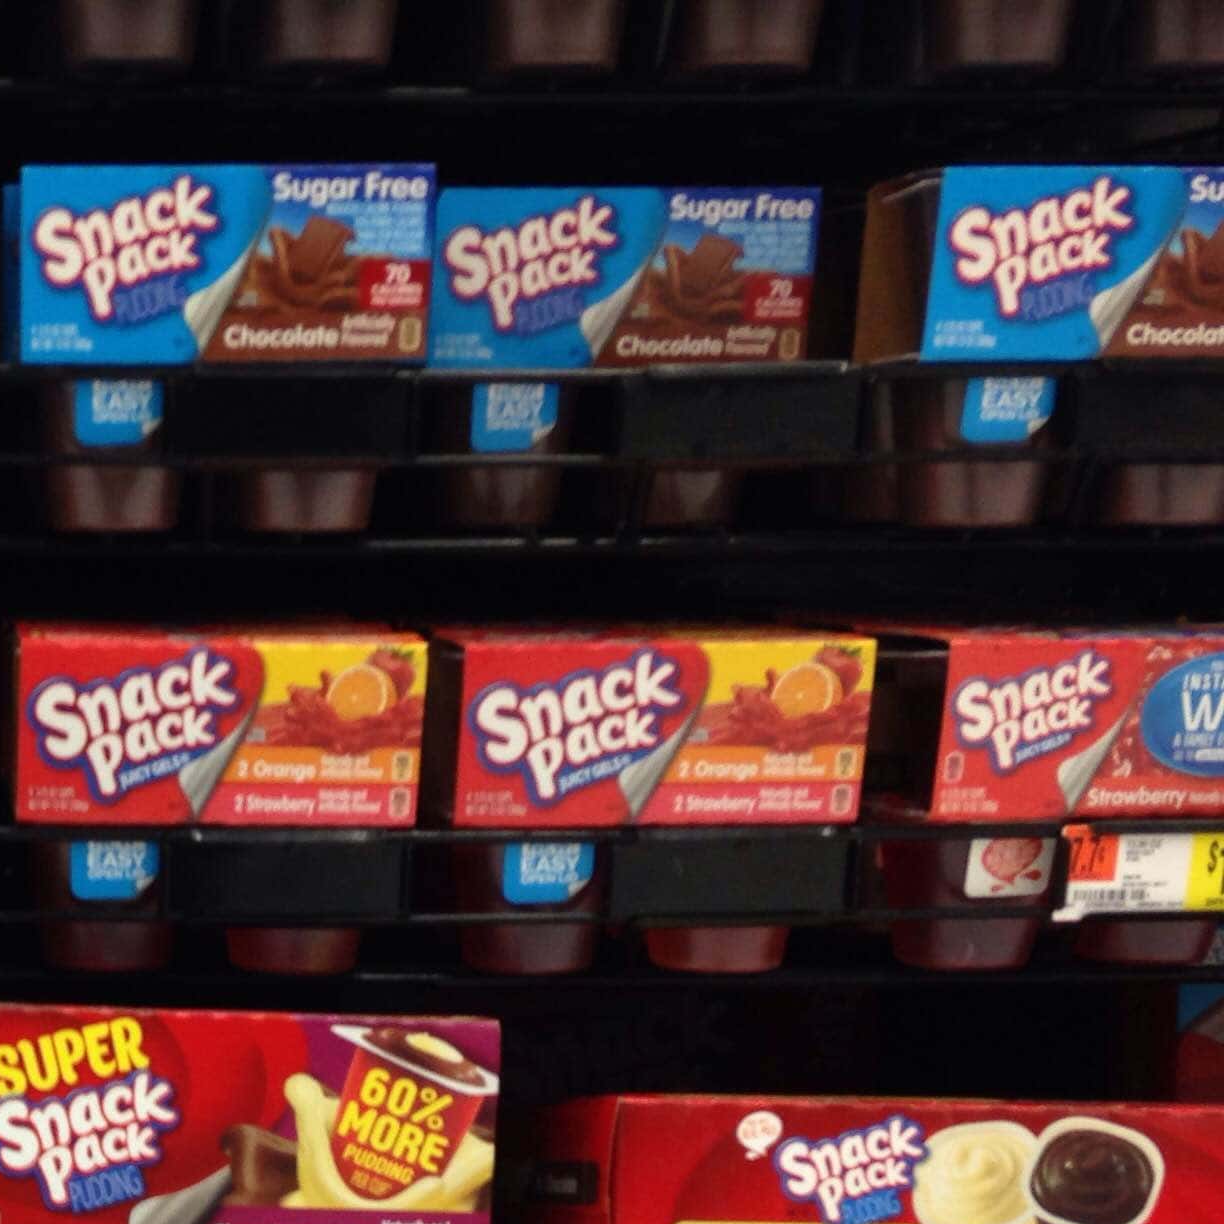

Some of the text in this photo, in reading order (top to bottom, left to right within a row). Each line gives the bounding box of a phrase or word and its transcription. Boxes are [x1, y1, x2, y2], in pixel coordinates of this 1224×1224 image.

[273, 174, 428, 205] Sugar Free
[670, 194, 813, 225] Sugar Free
[37, 177, 216, 284] Snack
[447, 197, 615, 296] Snack
[952, 177, 1132, 282] Snack
[224, 325, 338, 349] Chocolate
[617, 335, 723, 357] Chocolate
[36, 652, 235, 759] Snack
[478, 654, 679, 763] Snack
[957, 653, 1110, 741] Snack
[696, 761, 757, 782] Orange
[1087, 788, 1186, 807] Strawberry
[361, 1068, 454, 1130] 60%
[338, 1102, 448, 1172] MORE
[344, 1144, 412, 1185] PUDDING
[781, 1119, 925, 1195] Snack
